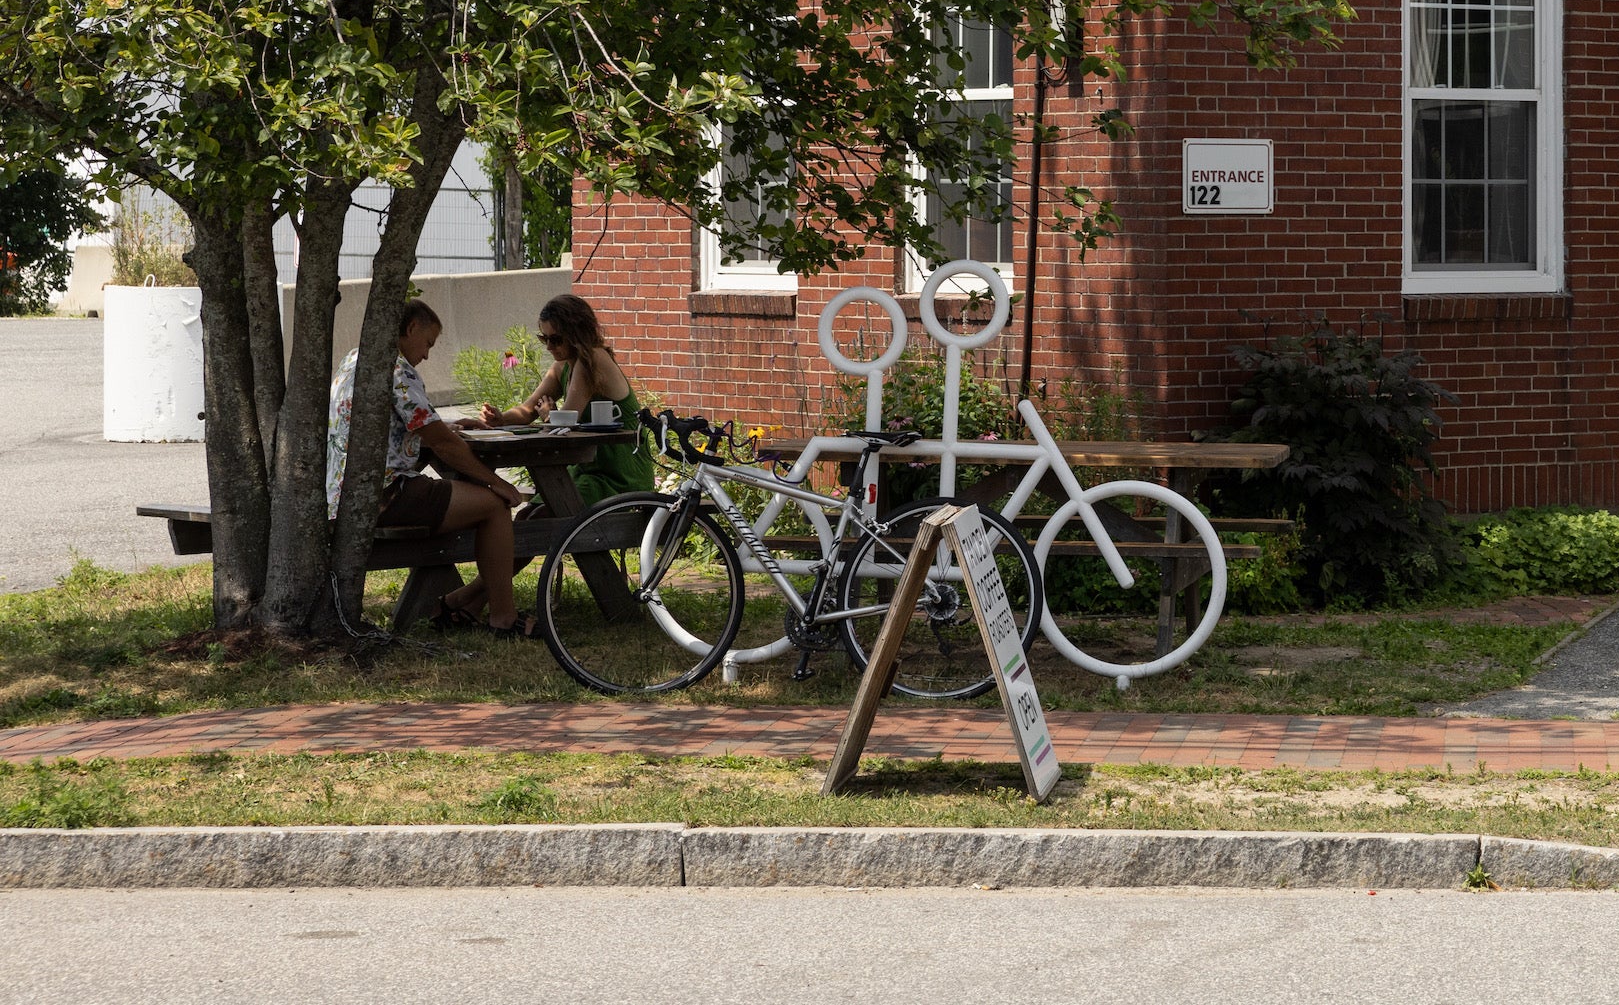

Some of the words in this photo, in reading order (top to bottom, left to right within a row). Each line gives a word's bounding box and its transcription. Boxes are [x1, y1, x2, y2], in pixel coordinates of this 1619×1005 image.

[1189, 185, 1221, 205] 122
[1191, 170, 1265, 183] ENTRANCE
[724, 505, 783, 574] SPECIALIZED
[962, 526, 990, 569] TANDEM
[976, 566, 1005, 613] COFFEE
[988, 607, 1015, 646] ROASTERS
[1017, 689, 1039, 732] OPEN
